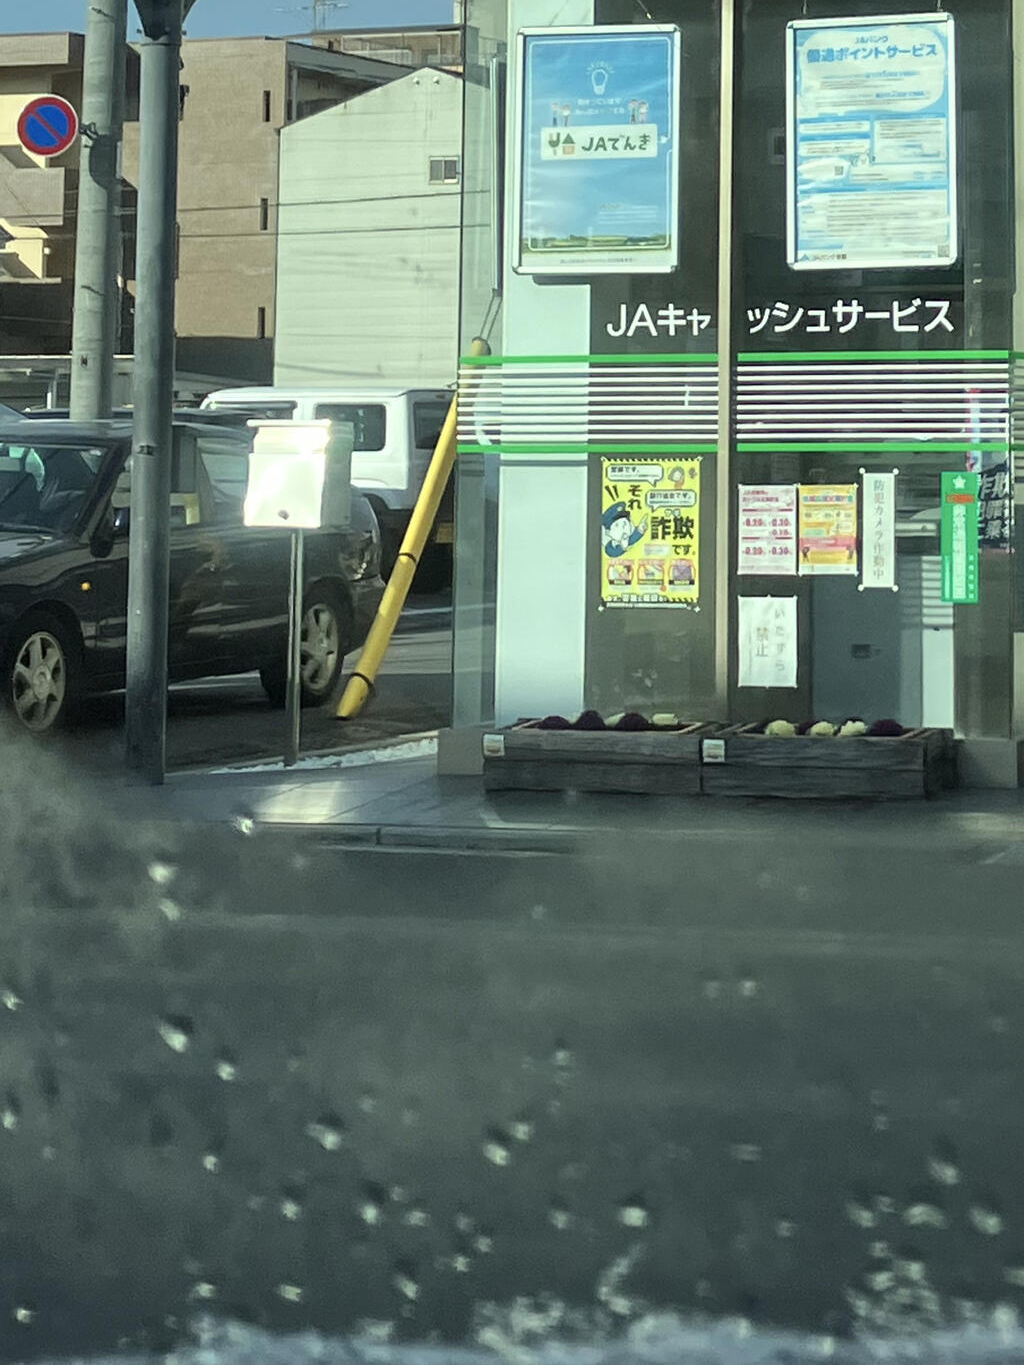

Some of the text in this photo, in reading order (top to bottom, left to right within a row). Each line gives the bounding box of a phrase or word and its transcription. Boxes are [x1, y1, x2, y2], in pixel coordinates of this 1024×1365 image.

[807, 43, 937, 63] 優遇ポイントサービス
[581, 134, 651, 151] JAでんき
[628, 484, 642, 510] それ
[651, 516, 694, 540] 詐欺
[756, 626, 768, 657] 禁止
[775, 608, 785, 672] いたずら
